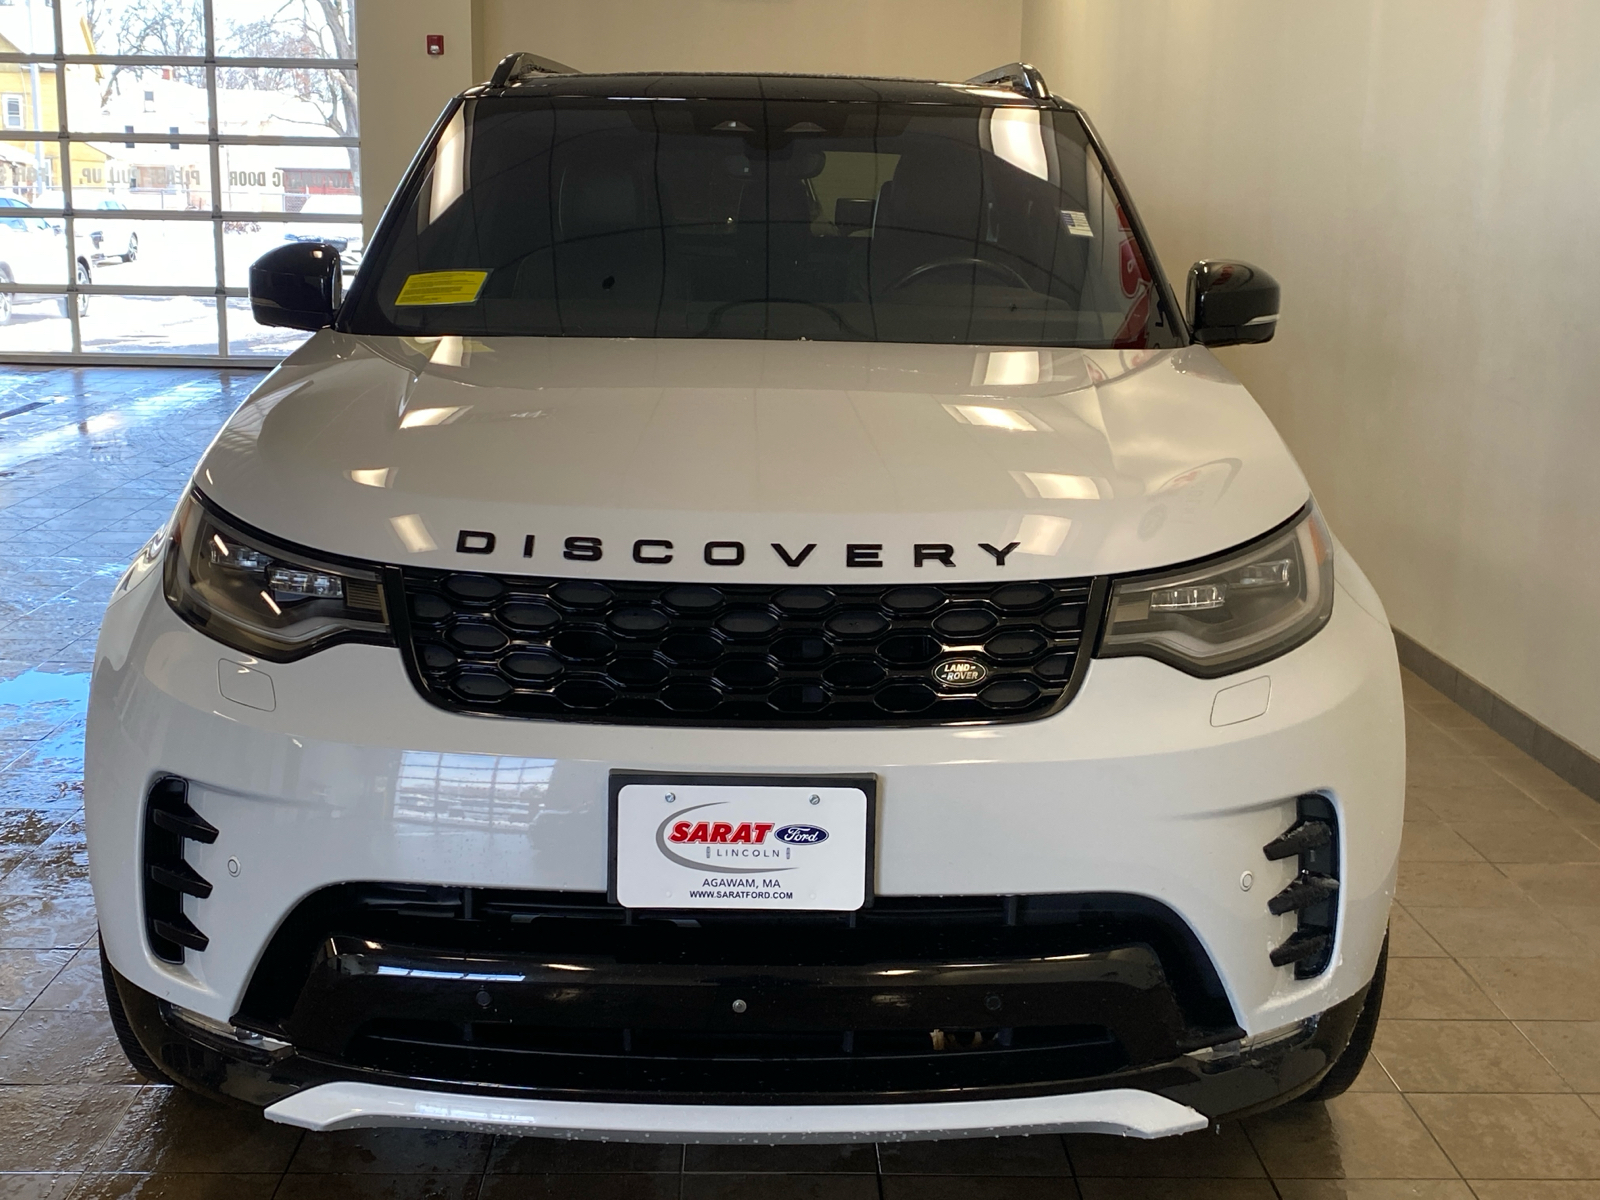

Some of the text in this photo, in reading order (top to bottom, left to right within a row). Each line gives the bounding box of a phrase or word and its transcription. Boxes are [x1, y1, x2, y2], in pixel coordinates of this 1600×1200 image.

[456, 529, 1021, 568] DISCOVERY
[944, 664, 970, 672] LAND
[947, 672, 979, 680] ROVER
[668, 821, 819, 845] SARAT Ford
[716, 849, 780, 858] LINCOLN
[702, 878, 781, 890] AGAWAM, MA
[689, 890, 794, 900] WWW.SARATFORD.COM
